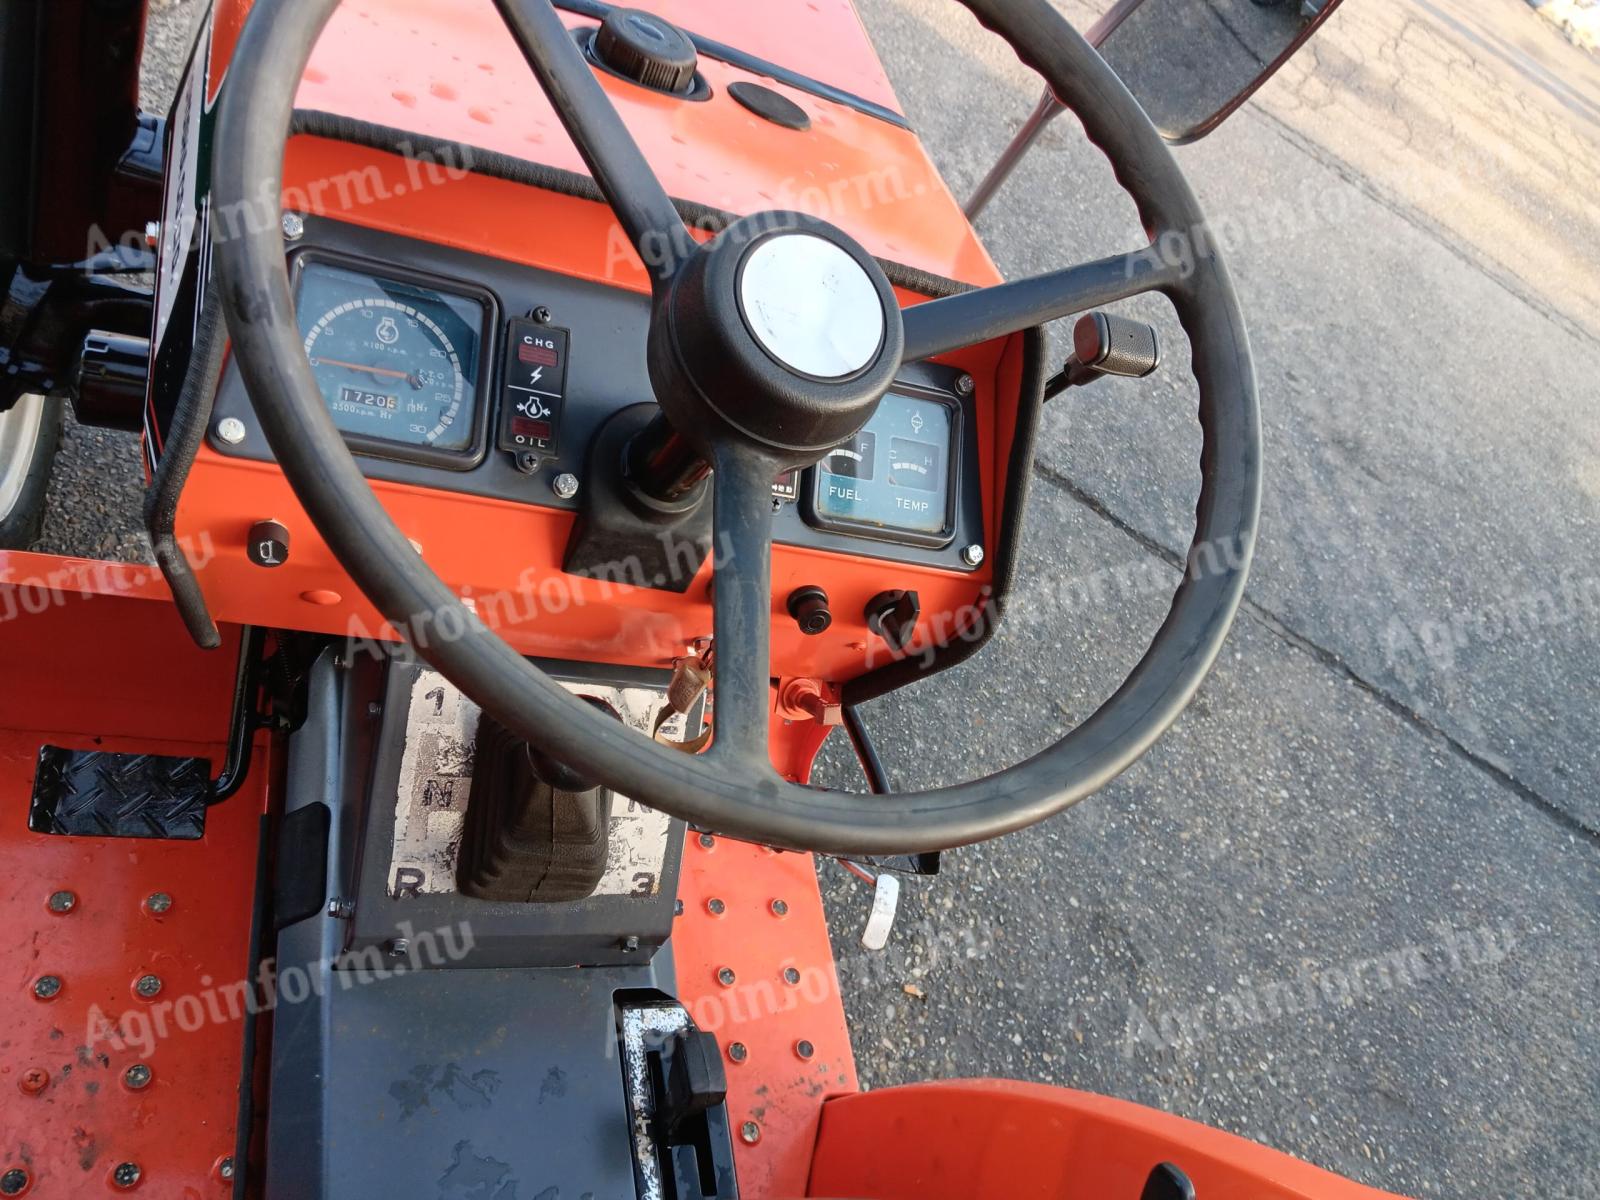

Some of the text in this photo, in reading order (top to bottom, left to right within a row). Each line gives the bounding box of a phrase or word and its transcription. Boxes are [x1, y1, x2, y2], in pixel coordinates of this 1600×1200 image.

[524, 335, 554, 349] CHG
[515, 435, 546, 448] OIL
[860, 443, 869, 453] F
[829, 487, 862, 502] FUEL
[896, 497, 928, 513] TEMP
[425, 686, 446, 717] 1
[422, 779, 454, 807] N
[393, 867, 426, 900] R
